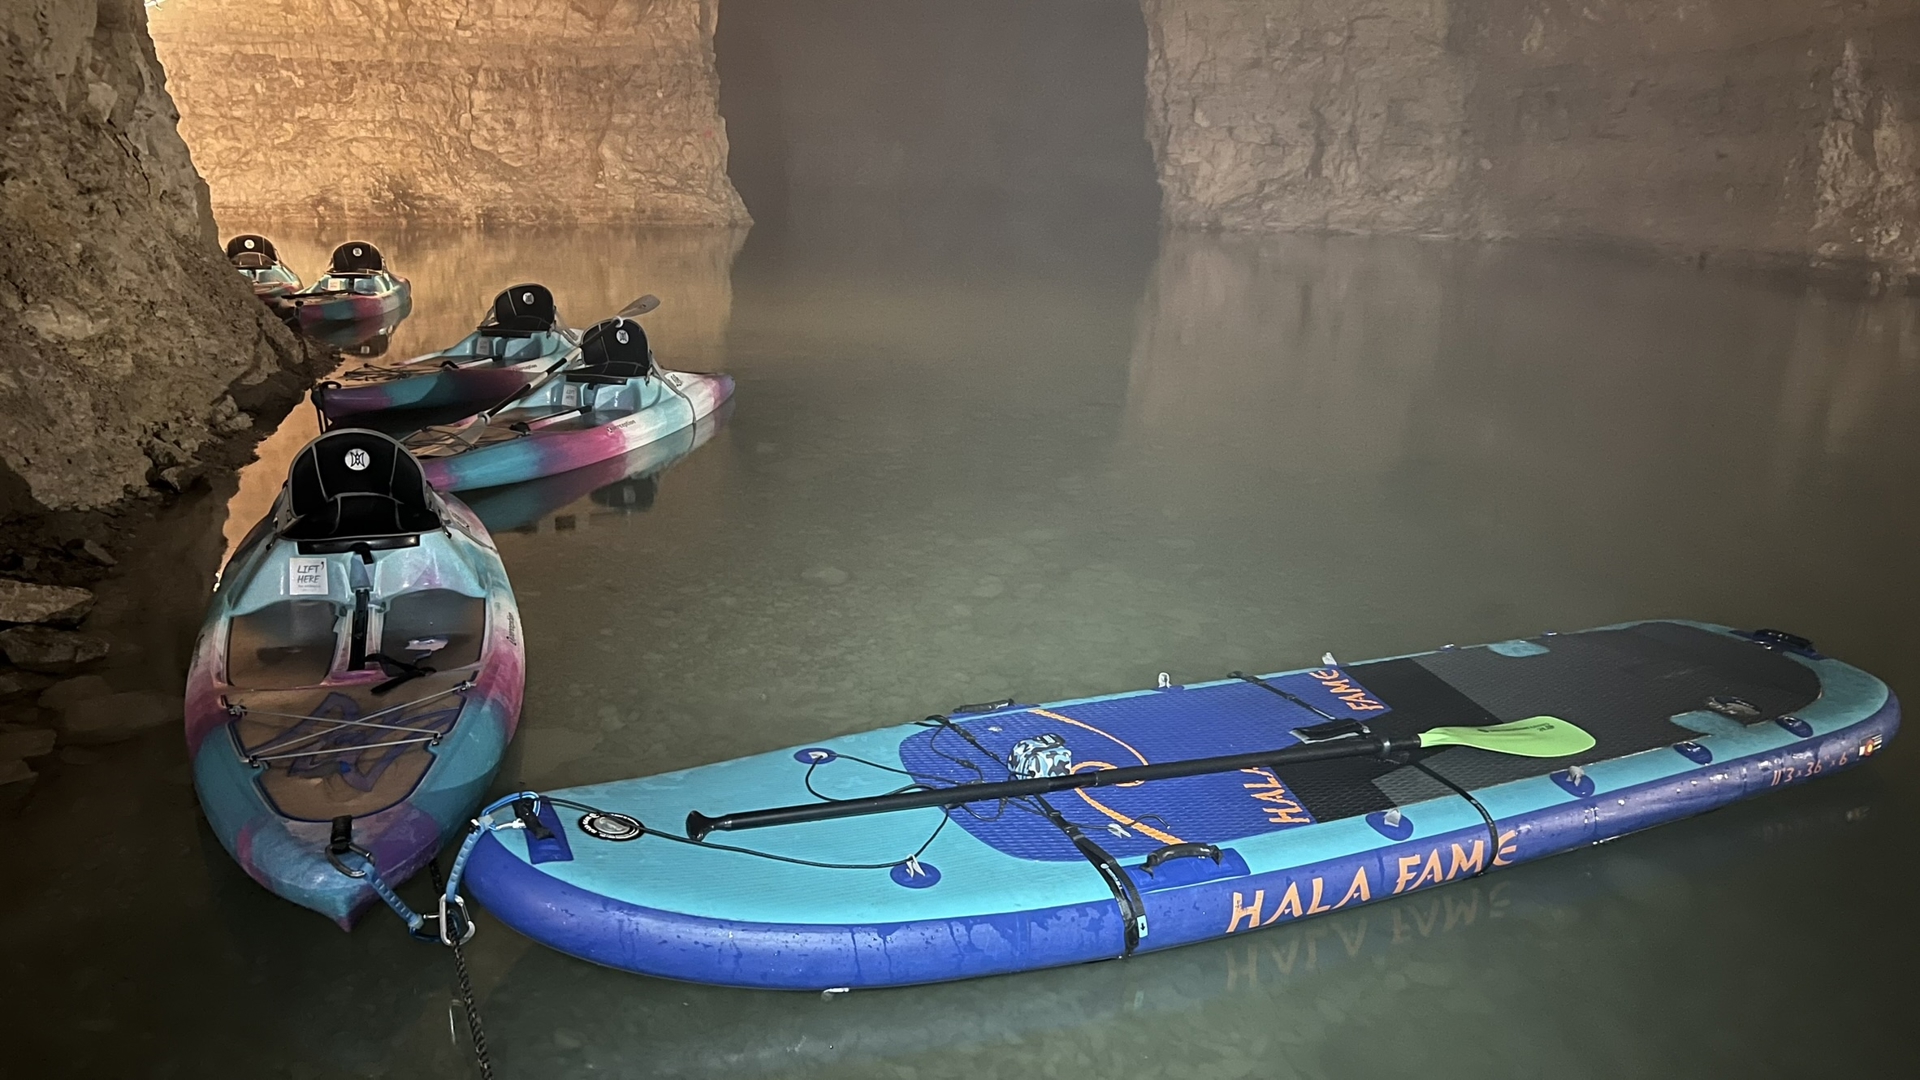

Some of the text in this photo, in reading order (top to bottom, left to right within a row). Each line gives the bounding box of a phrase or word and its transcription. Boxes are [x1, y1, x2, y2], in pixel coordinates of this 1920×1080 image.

[297, 564, 320, 574] LIFT
[297, 575, 321, 584] HERE
[1308, 669, 1385, 711] FAME
[1225, 829, 1518, 933] HALA FAME
